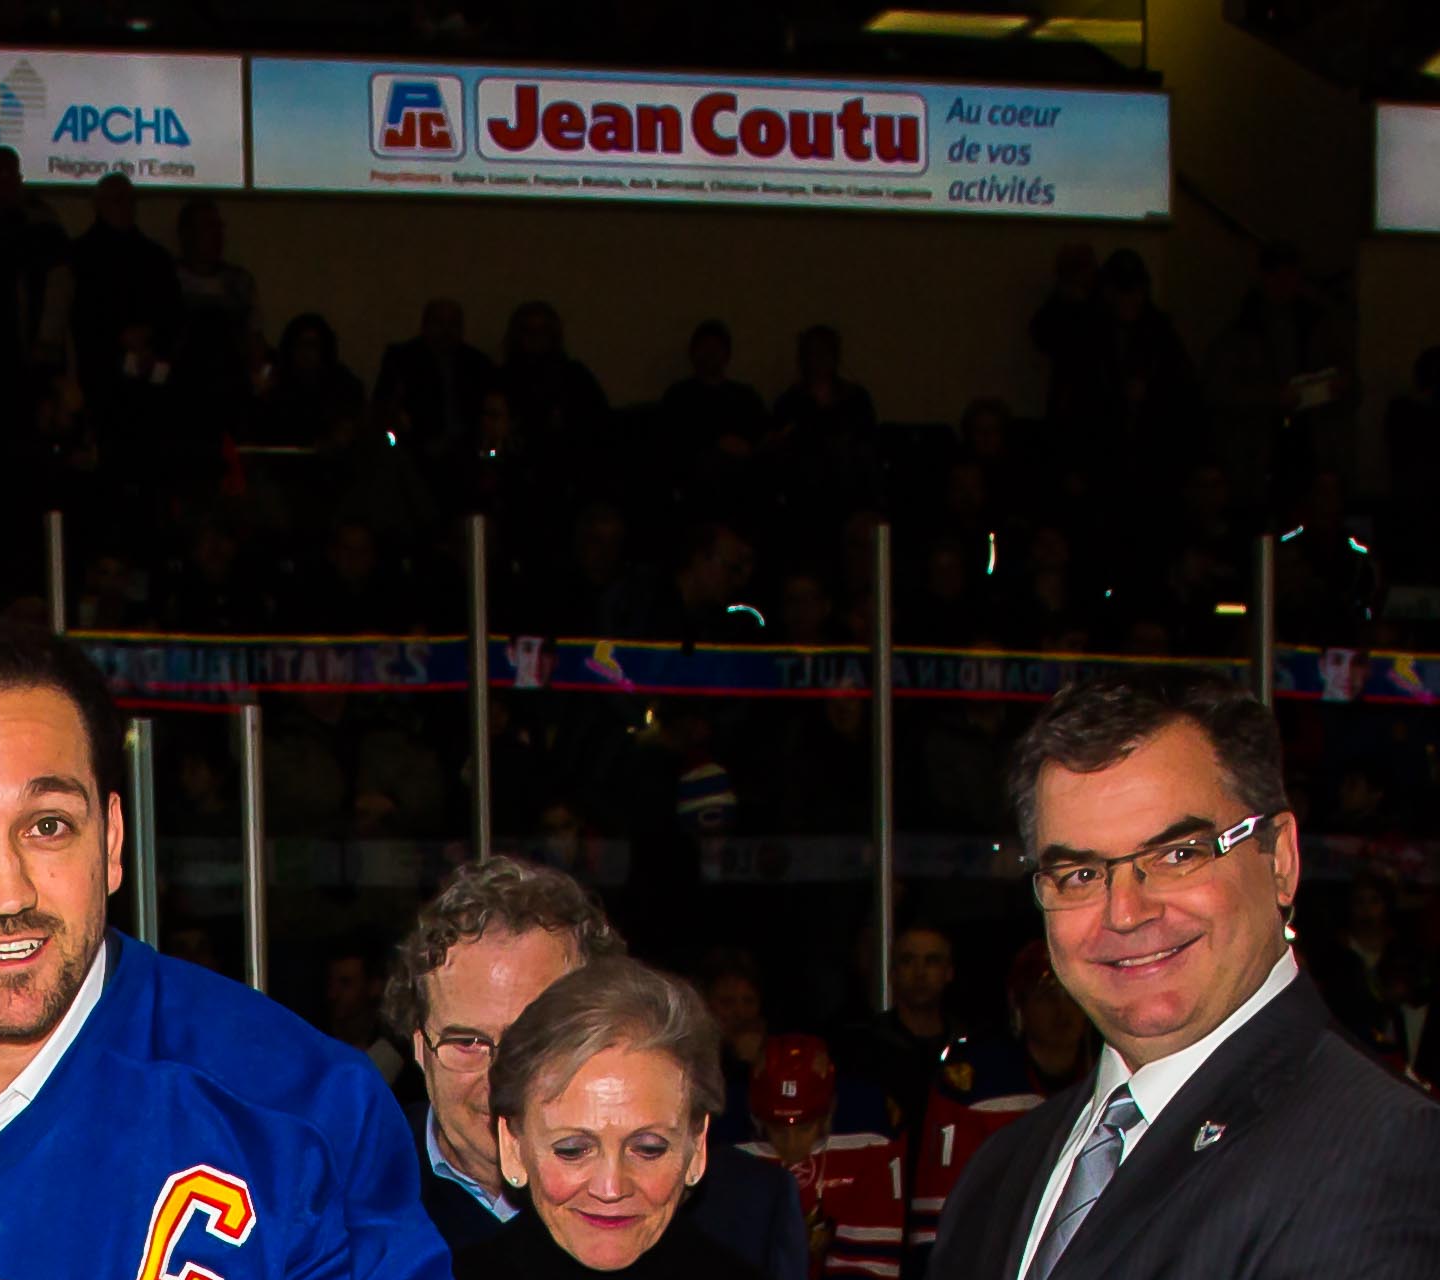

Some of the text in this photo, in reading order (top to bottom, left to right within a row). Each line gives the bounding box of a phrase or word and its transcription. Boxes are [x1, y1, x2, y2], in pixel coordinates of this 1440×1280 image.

[487, 84, 920, 163] Jean Coutu
[947, 97, 1062, 130] Au coeur
[948, 137, 1031, 167] de vos
[948, 177, 1056, 206] activités
